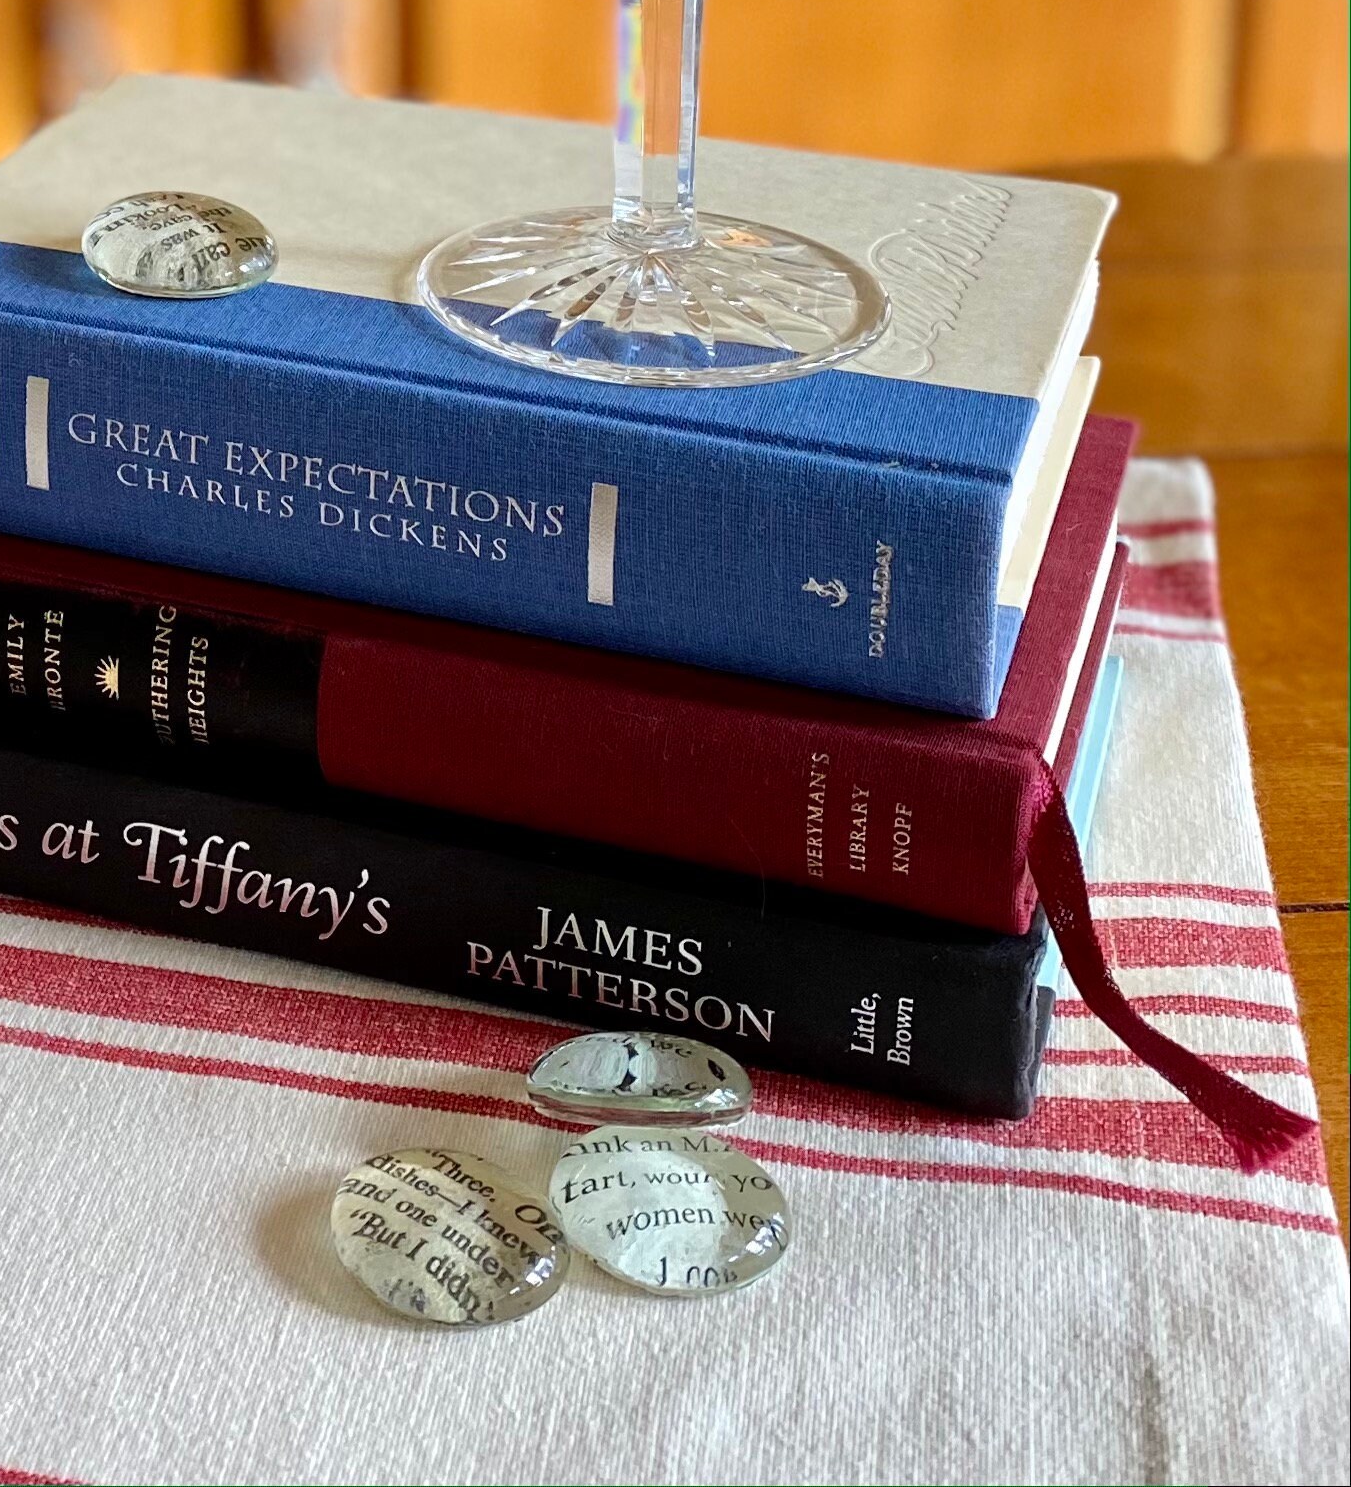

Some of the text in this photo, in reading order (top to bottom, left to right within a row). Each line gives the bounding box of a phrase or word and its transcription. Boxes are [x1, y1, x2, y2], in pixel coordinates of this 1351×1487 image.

[160, 227, 201, 250] was
[68, 412, 566, 538] GREAT EXPECTATIONS
[116, 463, 509, 562] CHARLES DICKENS
[6, 613, 27, 696] EMILY
[806, 751, 831, 878] EVERYMAN'S
[849, 783, 871, 873] LIBRARY
[891, 801, 913, 876] KNOPF
[40, 819, 101, 865] at
[122, 820, 392, 941] Tiffany's
[532, 905, 705, 977] JAMES
[466, 940, 777, 1043] PATTERSON
[850, 992, 883, 1056] Little,
[886, 996, 915, 1067] Brown
[640, 1139, 674, 1153] an
[560, 1170, 636, 1204] tart,
[606, 1206, 716, 1242] women
[343, 1177, 516, 1290] and one under
[405, 1237, 430, 1262] I
